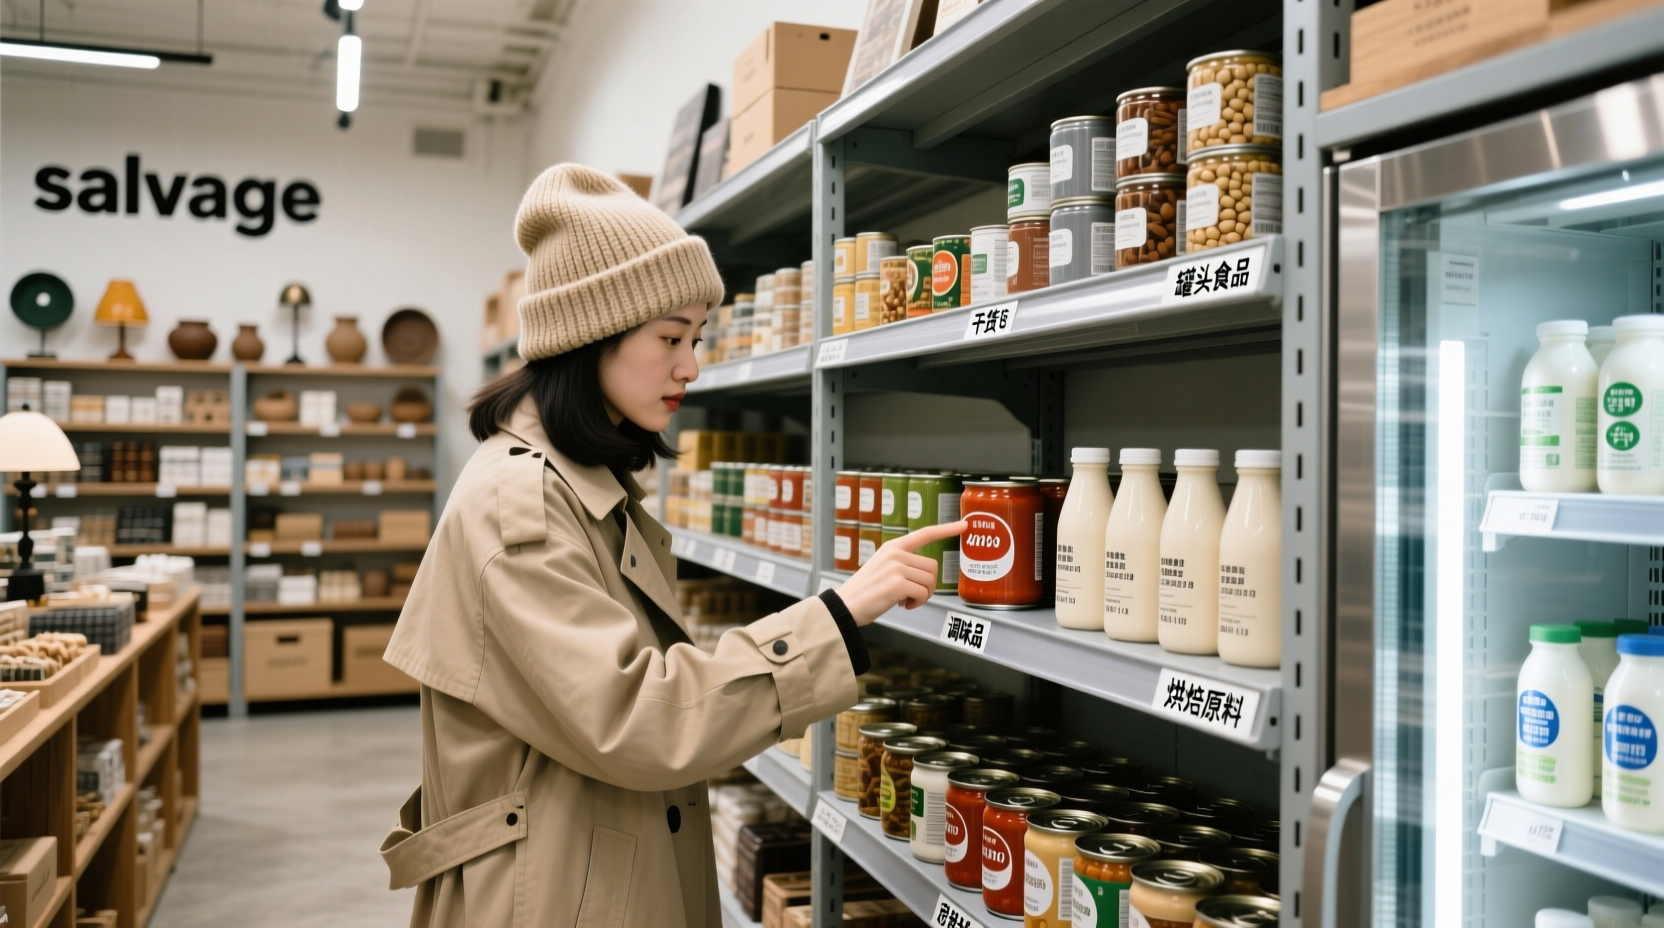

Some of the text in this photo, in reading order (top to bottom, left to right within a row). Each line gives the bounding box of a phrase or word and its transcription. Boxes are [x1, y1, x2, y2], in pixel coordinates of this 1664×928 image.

[34, 153, 321, 237] salvage
[1174, 257, 1250, 297] 罐头食品
[947, 616, 984, 649] 调味品
[1163, 677, 1244, 728] 烘焙原料
